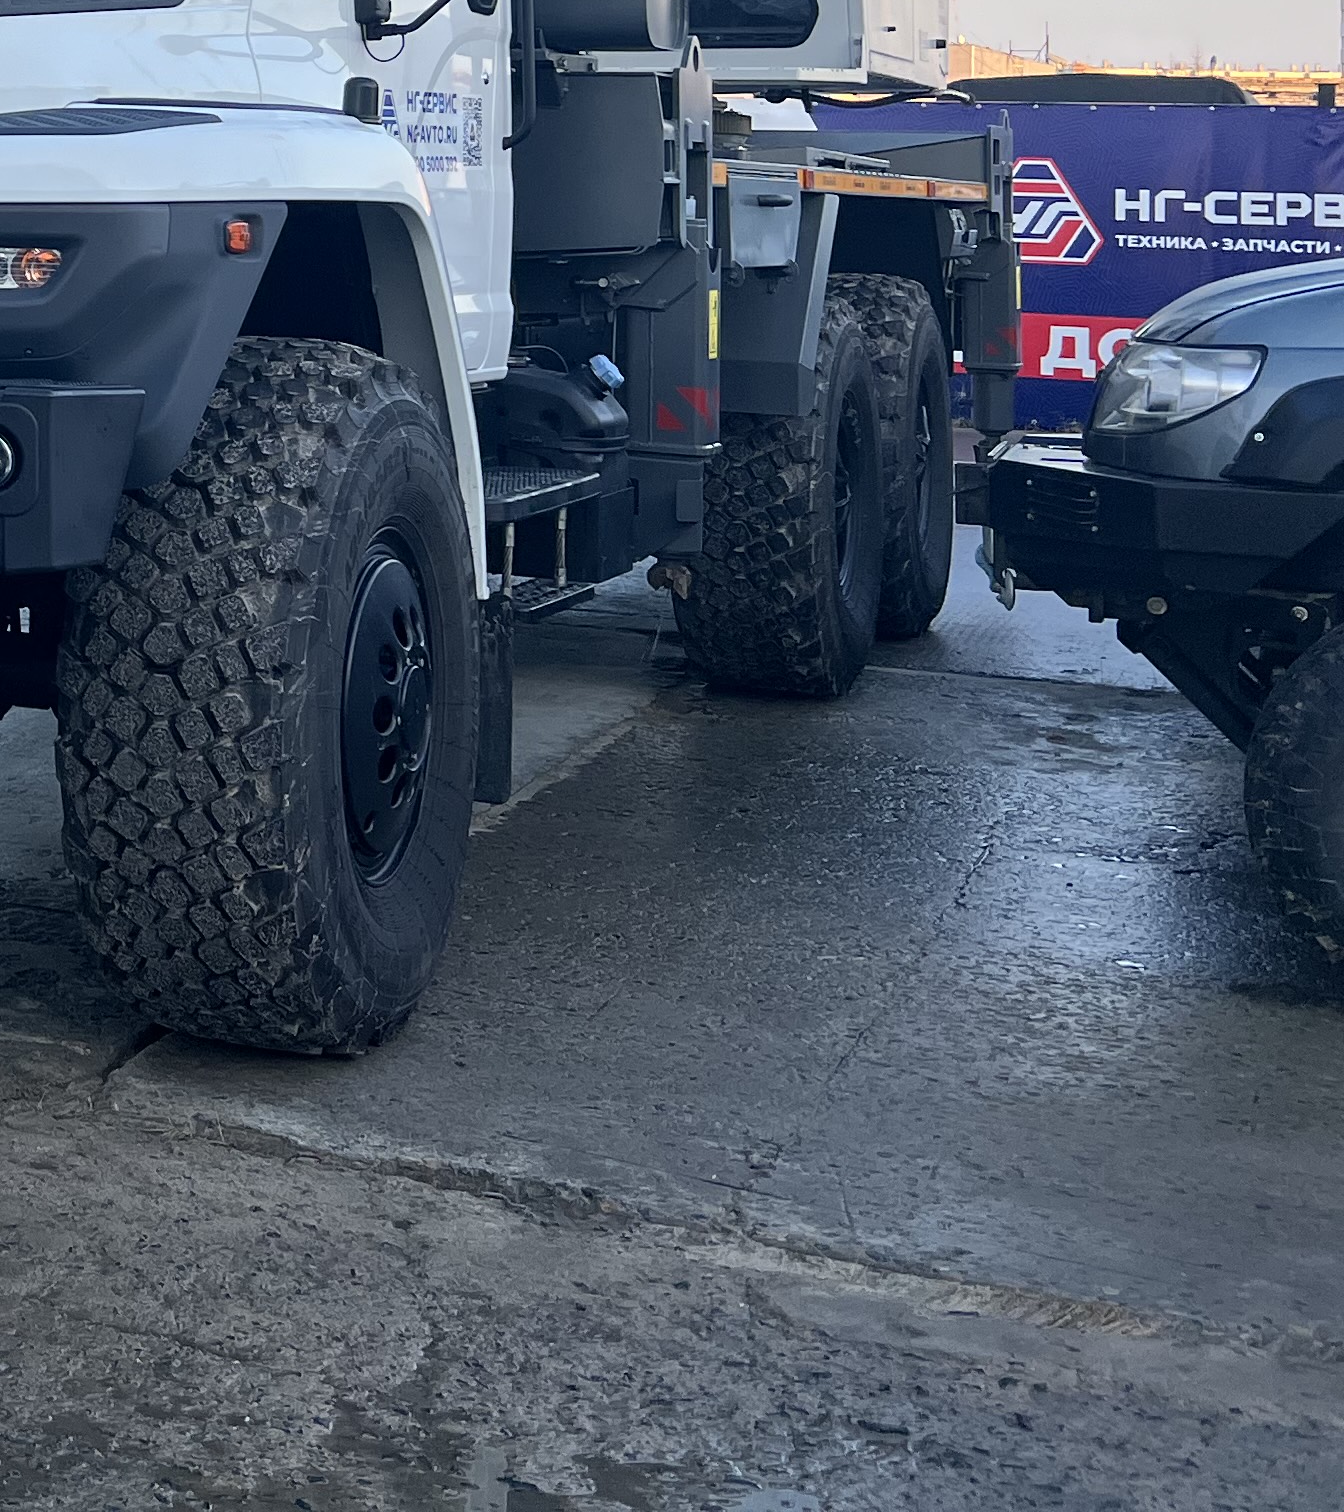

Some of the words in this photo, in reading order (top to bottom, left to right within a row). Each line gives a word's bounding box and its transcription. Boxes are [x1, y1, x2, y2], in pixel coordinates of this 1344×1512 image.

[406, 90, 457, 114] НГ-СЕРВИС
[406, 124, 458, 144] NG-AVTO.RU
[1114, 187, 1344, 228] НГ-СЕРВ
[1114, 234, 1208, 251] ТЕХНИКА
[1222, 238, 1331, 254] ЗАПЧАСТИ
